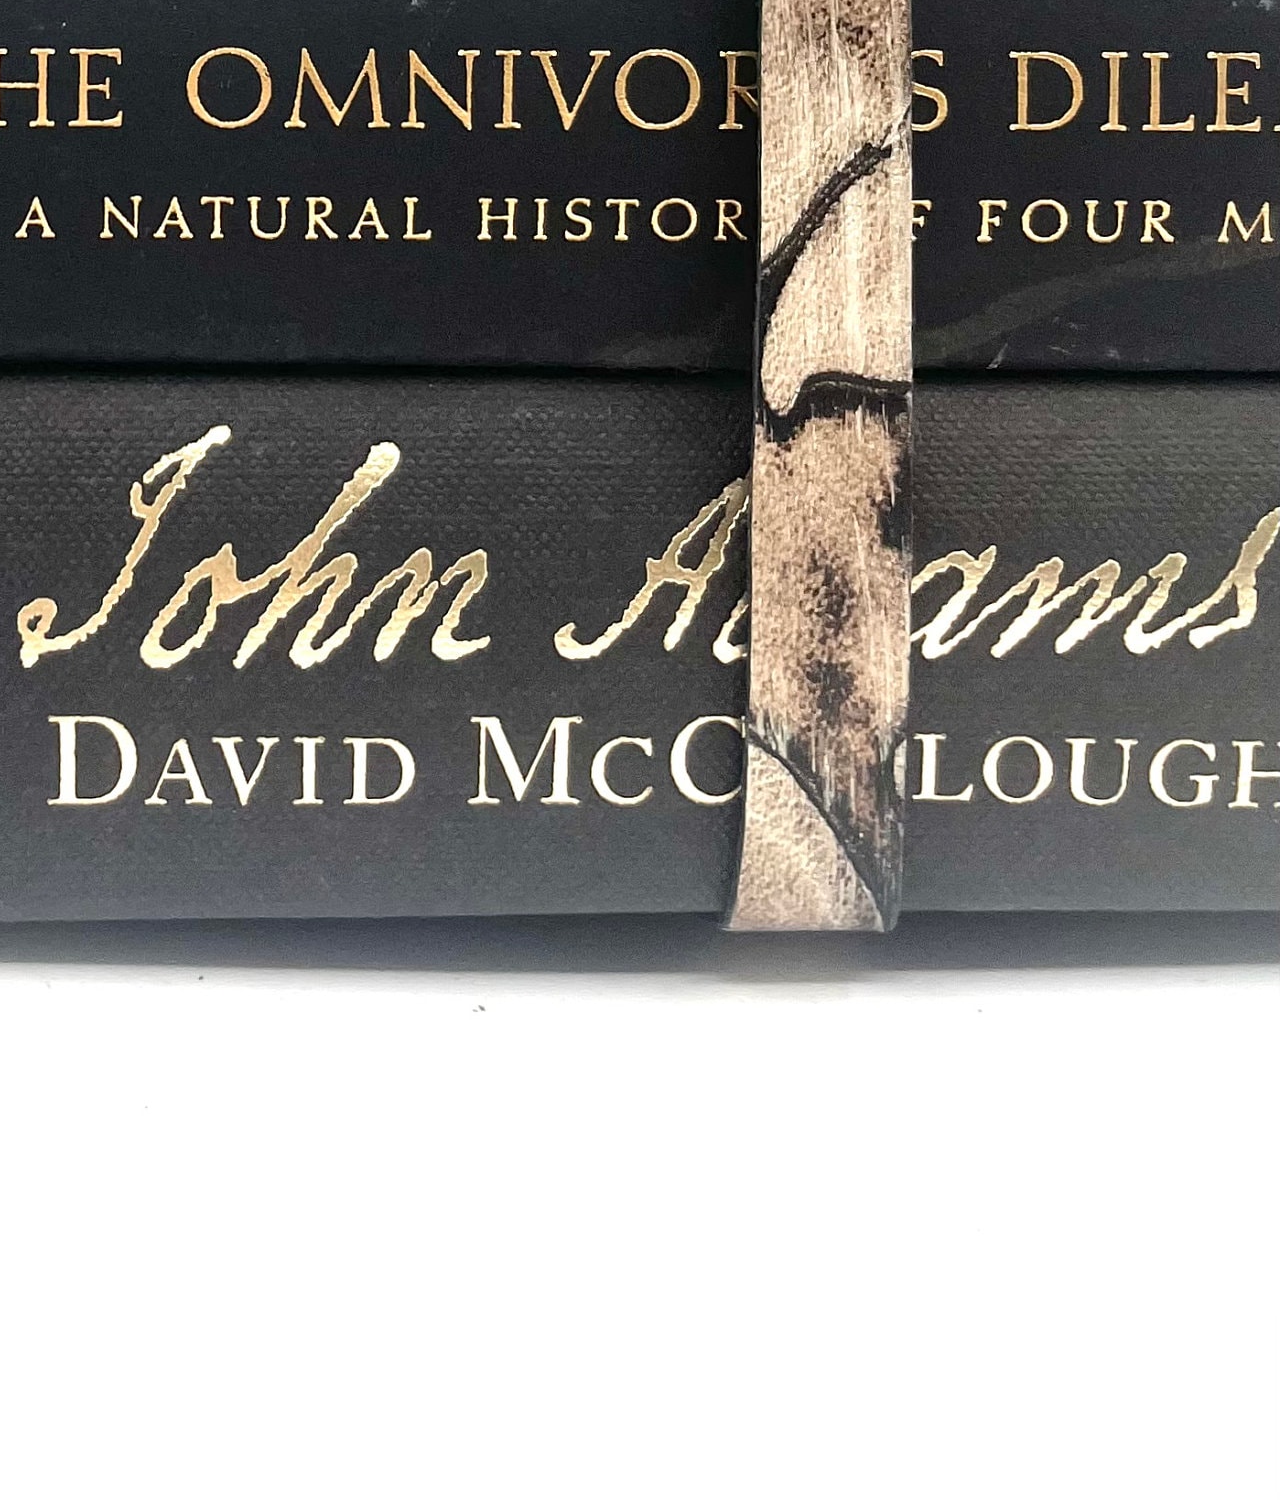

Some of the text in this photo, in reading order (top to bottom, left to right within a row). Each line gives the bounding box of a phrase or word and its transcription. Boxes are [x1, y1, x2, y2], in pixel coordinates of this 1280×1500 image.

[185, 46, 949, 133] OMNIVORS
[1008, 50, 1280, 132] DILE
[14, 195, 57, 240] A
[99, 195, 432, 241] NATURAL
[477, 197, 748, 242] HISTOR
[977, 199, 1175, 243] FOUR
[1217, 200, 1275, 243] M
[16, 425, 490, 670] John
